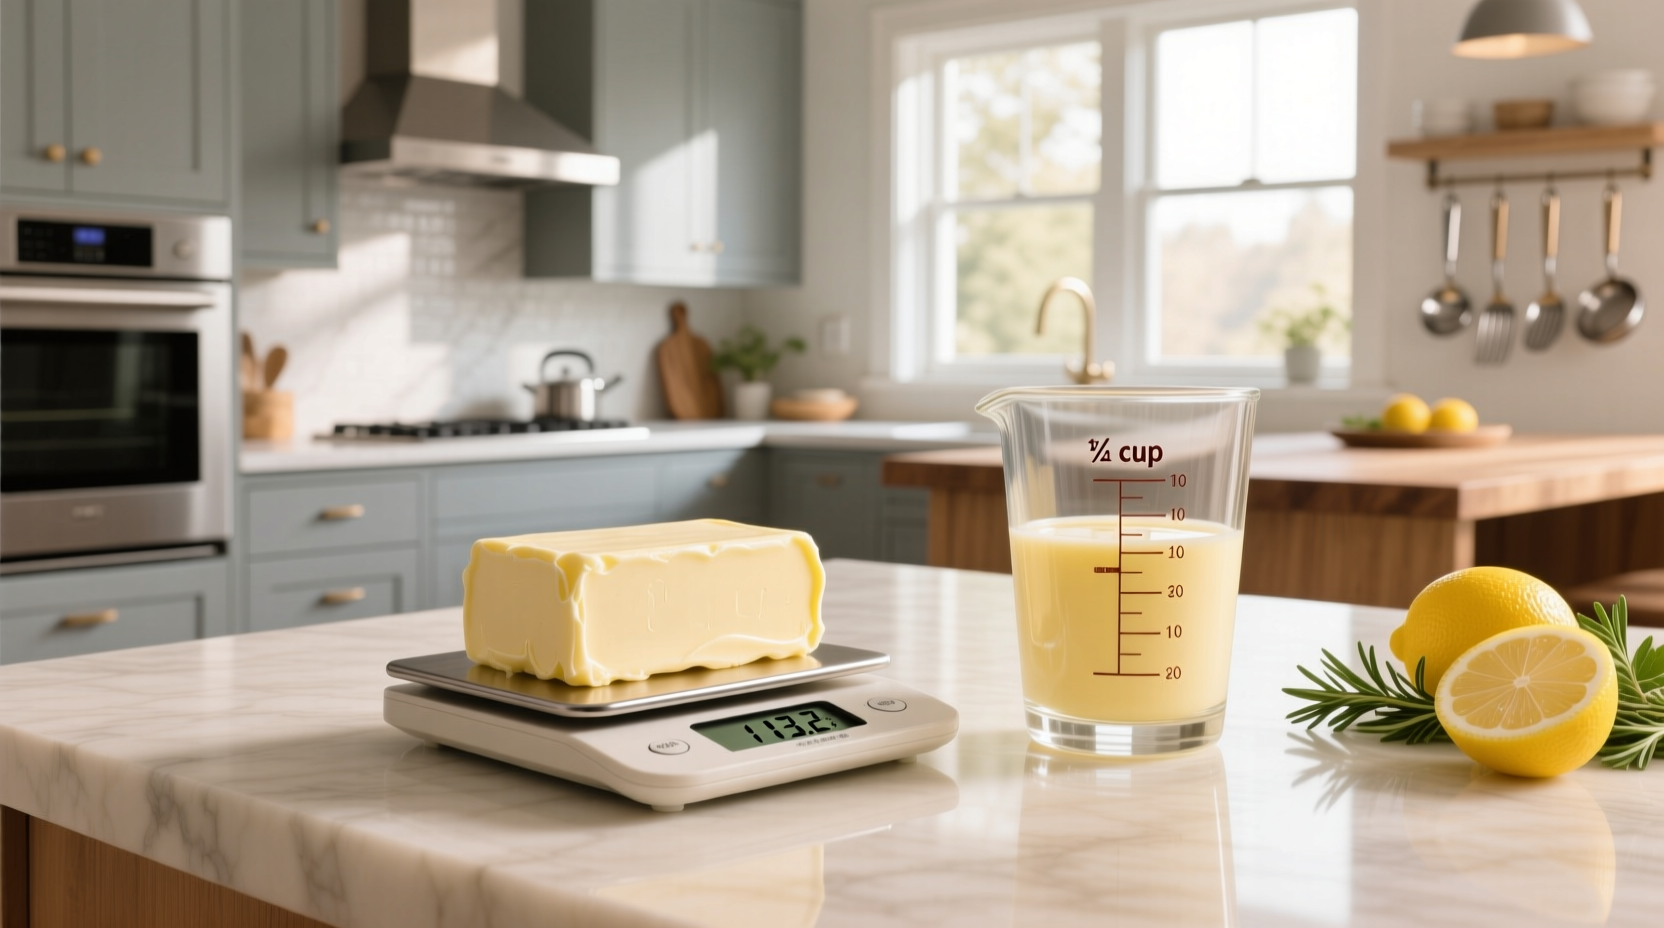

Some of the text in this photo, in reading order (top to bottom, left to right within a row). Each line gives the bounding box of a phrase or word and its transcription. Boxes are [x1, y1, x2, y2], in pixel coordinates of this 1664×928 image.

[1119, 445, 1163, 468] cup
[1170, 474, 1187, 487] 10
[1171, 507, 1185, 521] 10
[1168, 545, 1185, 559] 10
[1166, 625, 1182, 639] 10
[1165, 666, 1182, 680] 20
[744, 710, 831, 743] 113.2
